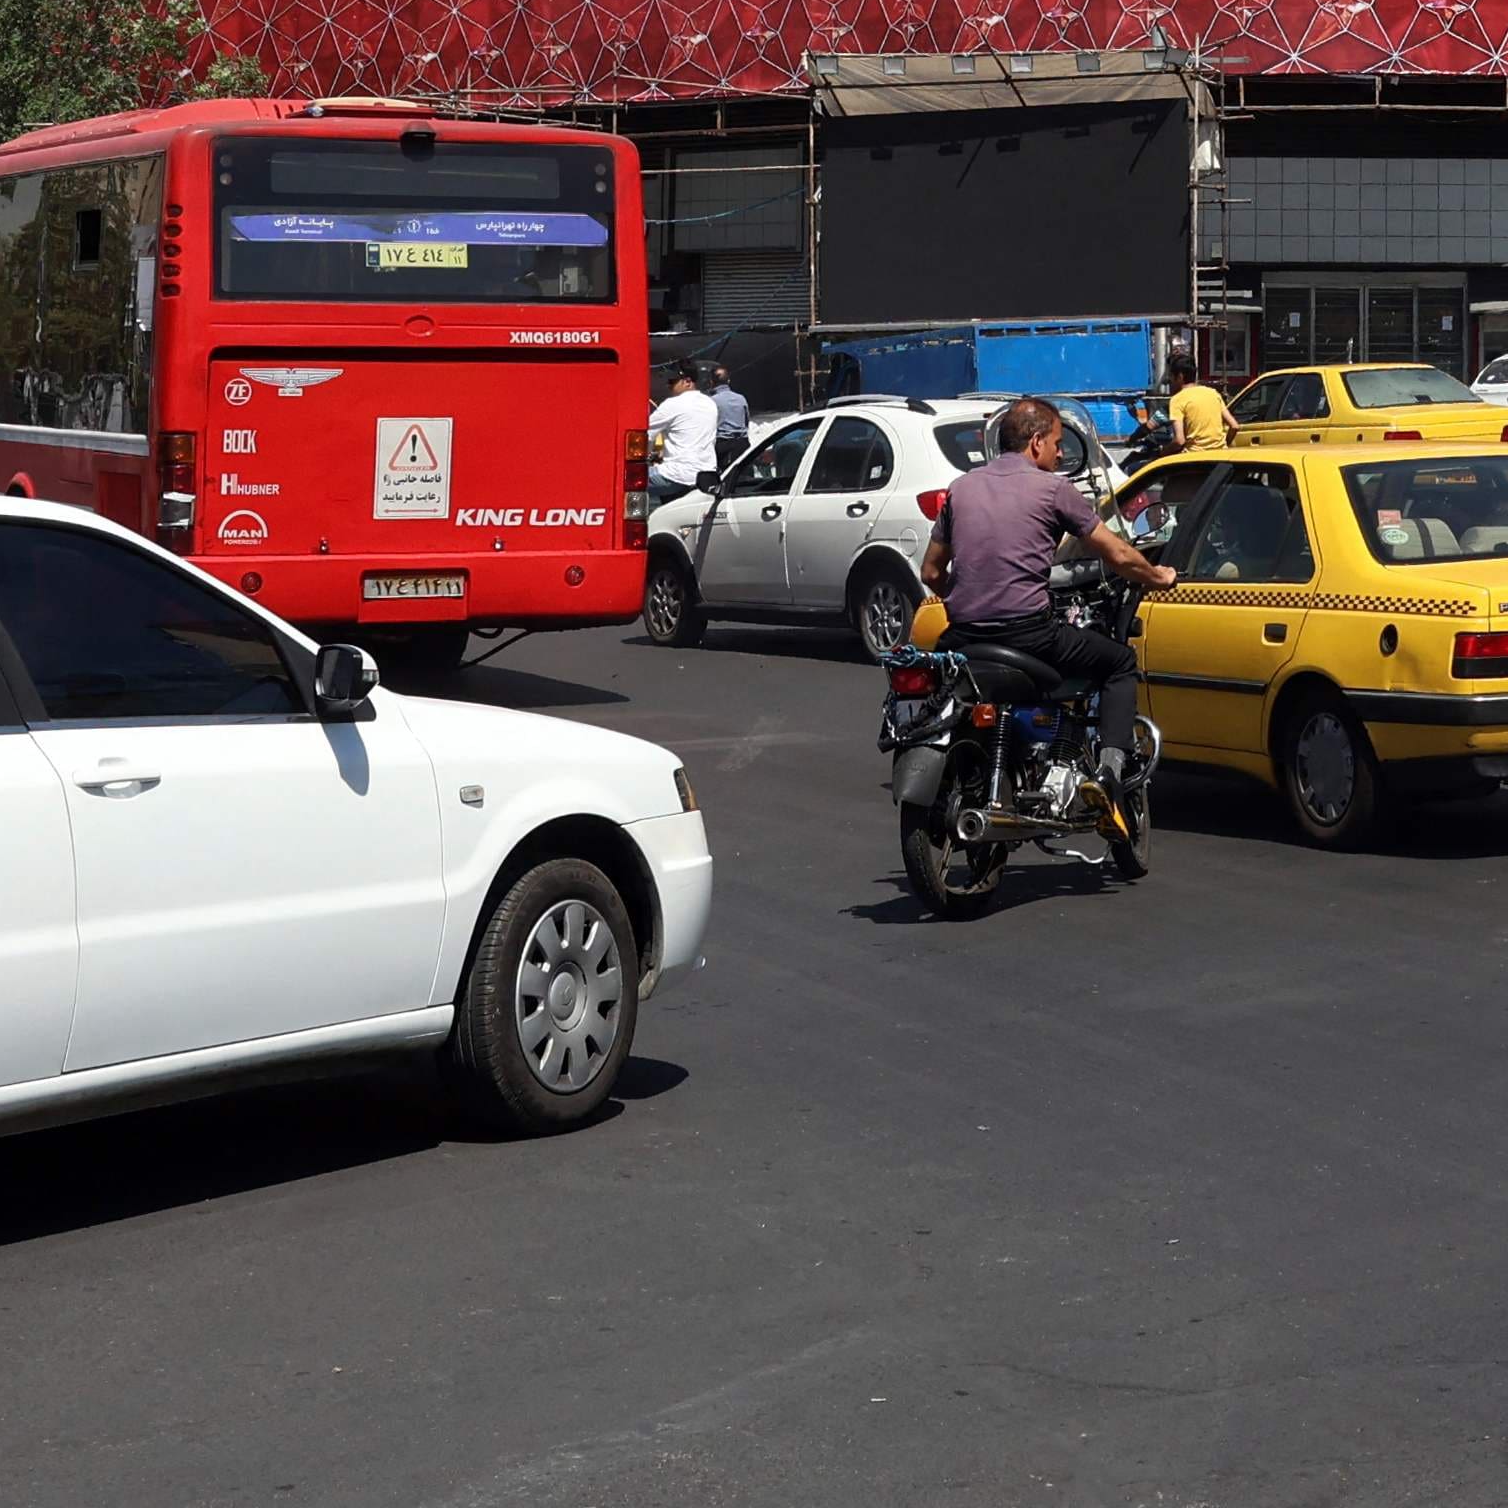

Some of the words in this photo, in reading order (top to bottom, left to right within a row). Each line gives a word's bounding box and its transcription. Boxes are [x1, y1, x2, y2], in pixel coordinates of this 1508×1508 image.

[274, 216, 298, 227] آزادی
[298, 218, 333, 229] پایانه
[510, 332, 600, 344] XMQ6180G1
[223, 430, 256, 453] BOCK
[420, 473, 442, 483] فاصله
[238, 484, 280, 495] HUBNER
[416, 492, 441, 503] رعایت
[455, 508, 523, 526] KING
[529, 508, 606, 526] LONG
[223, 529, 262, 538] MAN
